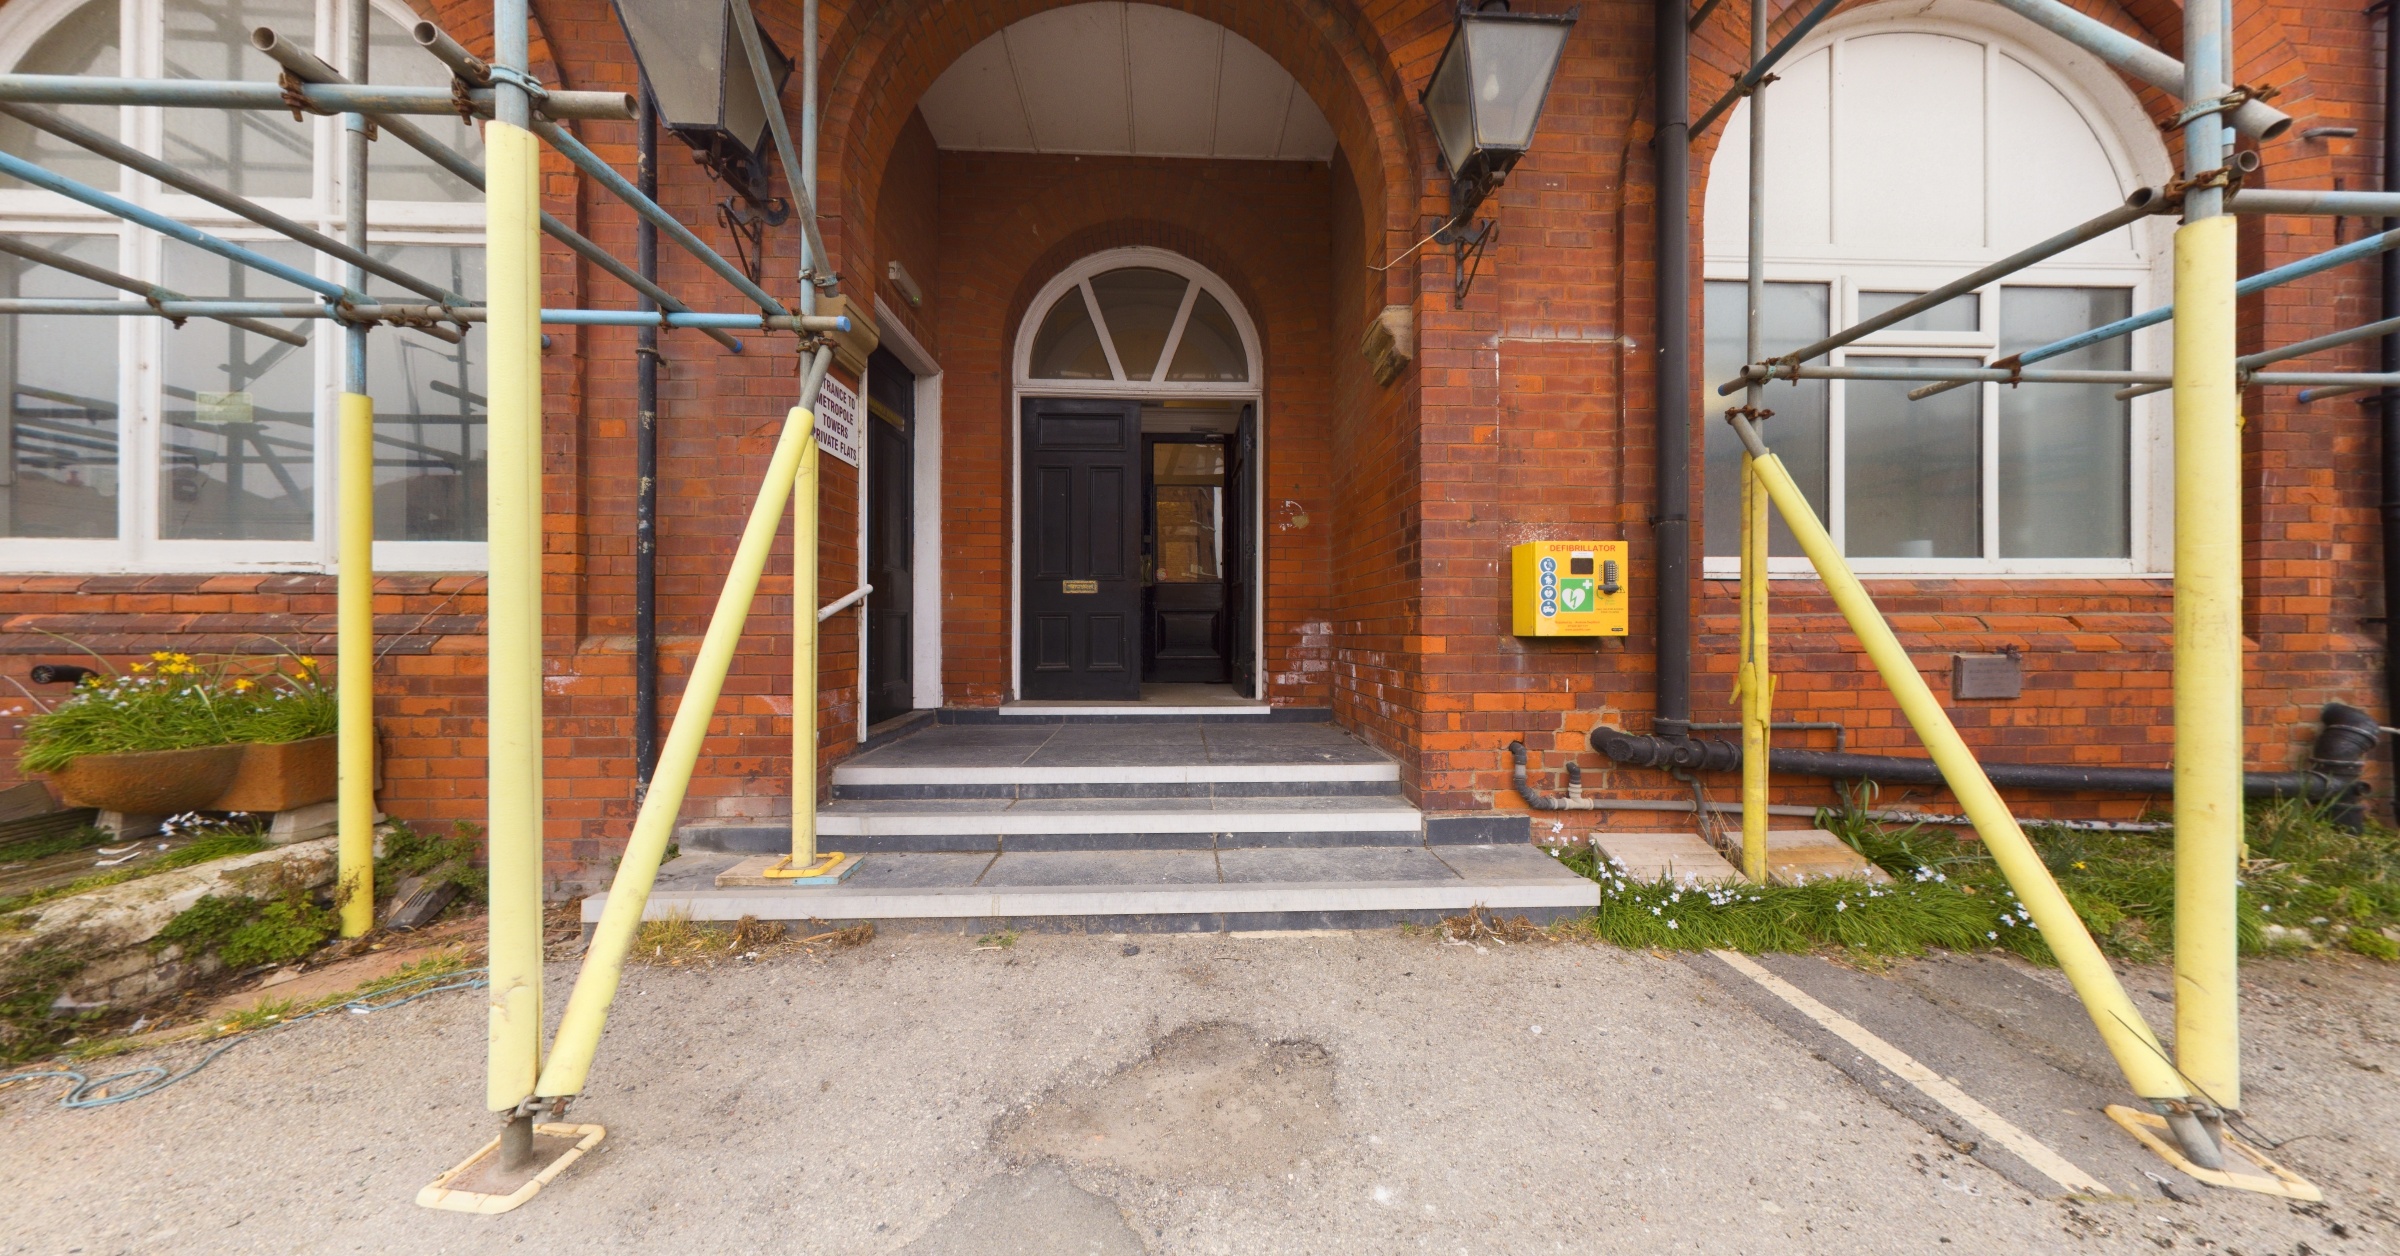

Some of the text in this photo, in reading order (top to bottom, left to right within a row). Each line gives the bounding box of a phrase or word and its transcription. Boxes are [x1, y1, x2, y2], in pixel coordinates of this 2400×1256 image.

[822, 378, 855, 410] TRANCE TO
[816, 393, 853, 426] METROPOLE
[822, 413, 848, 439] TOWERS
[840, 441, 856, 461] FLATS
